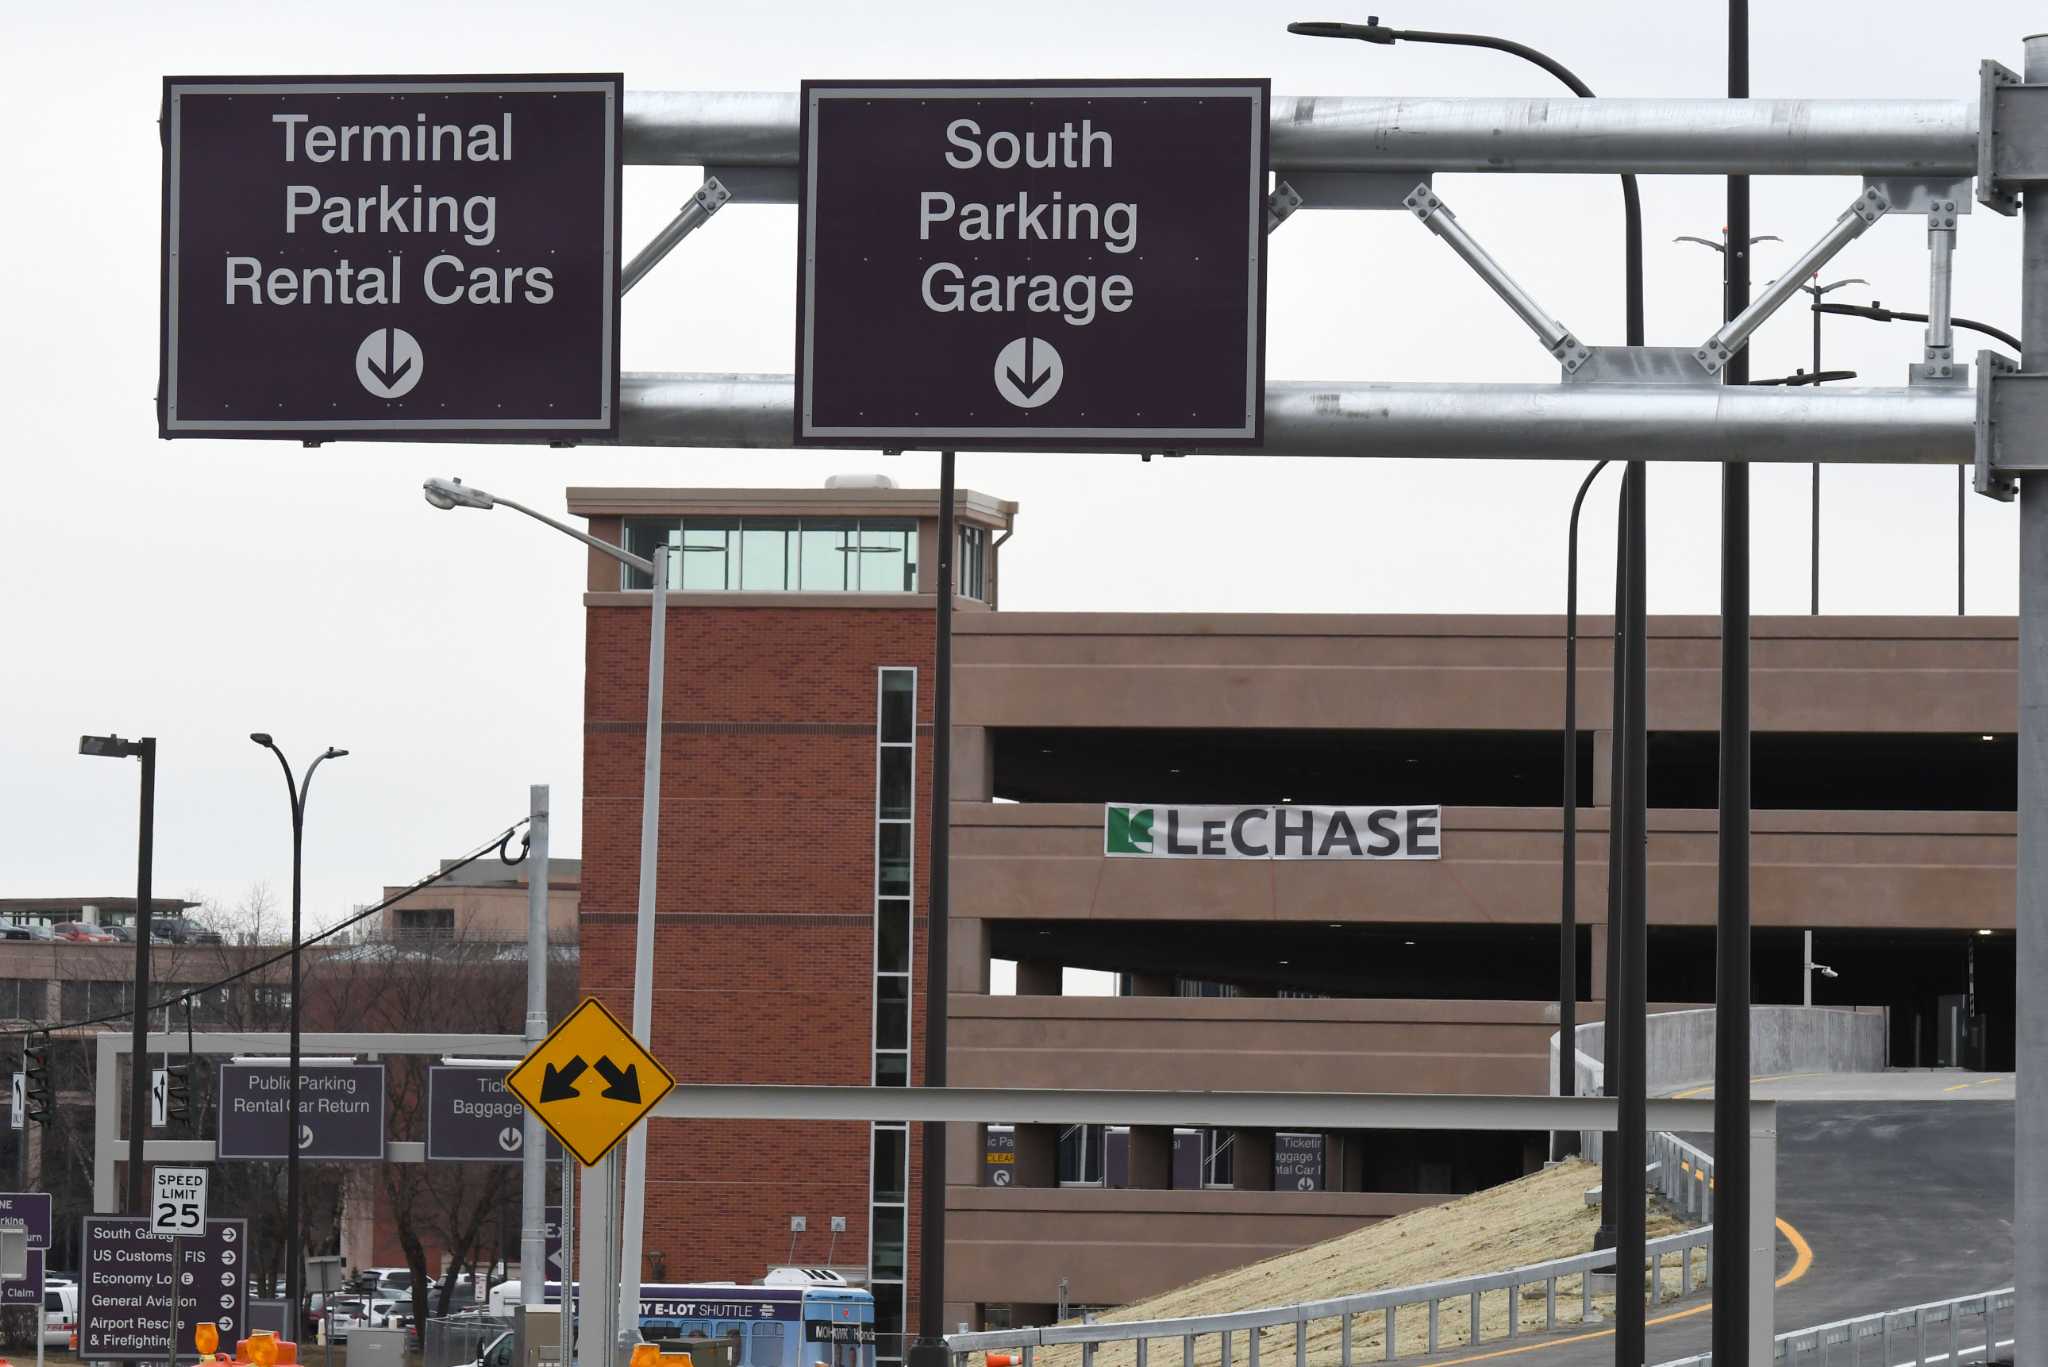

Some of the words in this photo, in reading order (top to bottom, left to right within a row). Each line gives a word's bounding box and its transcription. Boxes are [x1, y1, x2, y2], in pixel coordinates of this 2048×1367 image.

[272, 112, 512, 163] Terminal
[944, 118, 1113, 169] South
[286, 185, 496, 246] Parking
[919, 191, 1138, 254] Parking
[226, 255, 400, 305] Rental
[423, 254, 554, 305] Cars
[921, 261, 1134, 326] Garage
[299, 1075, 356, 1095] Parking
[234, 1098, 283, 1113] Rental
[286, 1099, 314, 1113] ar
[318, 1098, 370, 1113] Return
[453, 1099, 523, 1118] Baggage
[158, 1175, 203, 1186] SPEED
[162, 1189, 197, 1200] LIMIT
[157, 1203, 200, 1228] 25
[94, 1228, 131, 1240] South
[93, 1250, 112, 1262] US
[116, 1250, 173, 1263] Customs
[185, 1251, 206, 1263] FIS
[93, 1272, 153, 1287] Economy
[156, 1273, 172, 1284] Lo
[8, 1288, 34, 1297] Claim
[92, 1294, 141, 1307] General
[145, 1295, 197, 1307] Aviaion
[655, 1303, 696, 1316] E-LOT
[699, 1304, 752, 1317] SHUTTLE
[90, 1317, 134, 1331] Airport
[137, 1317, 185, 1330] Resce
[90, 1335, 99, 1345] &
